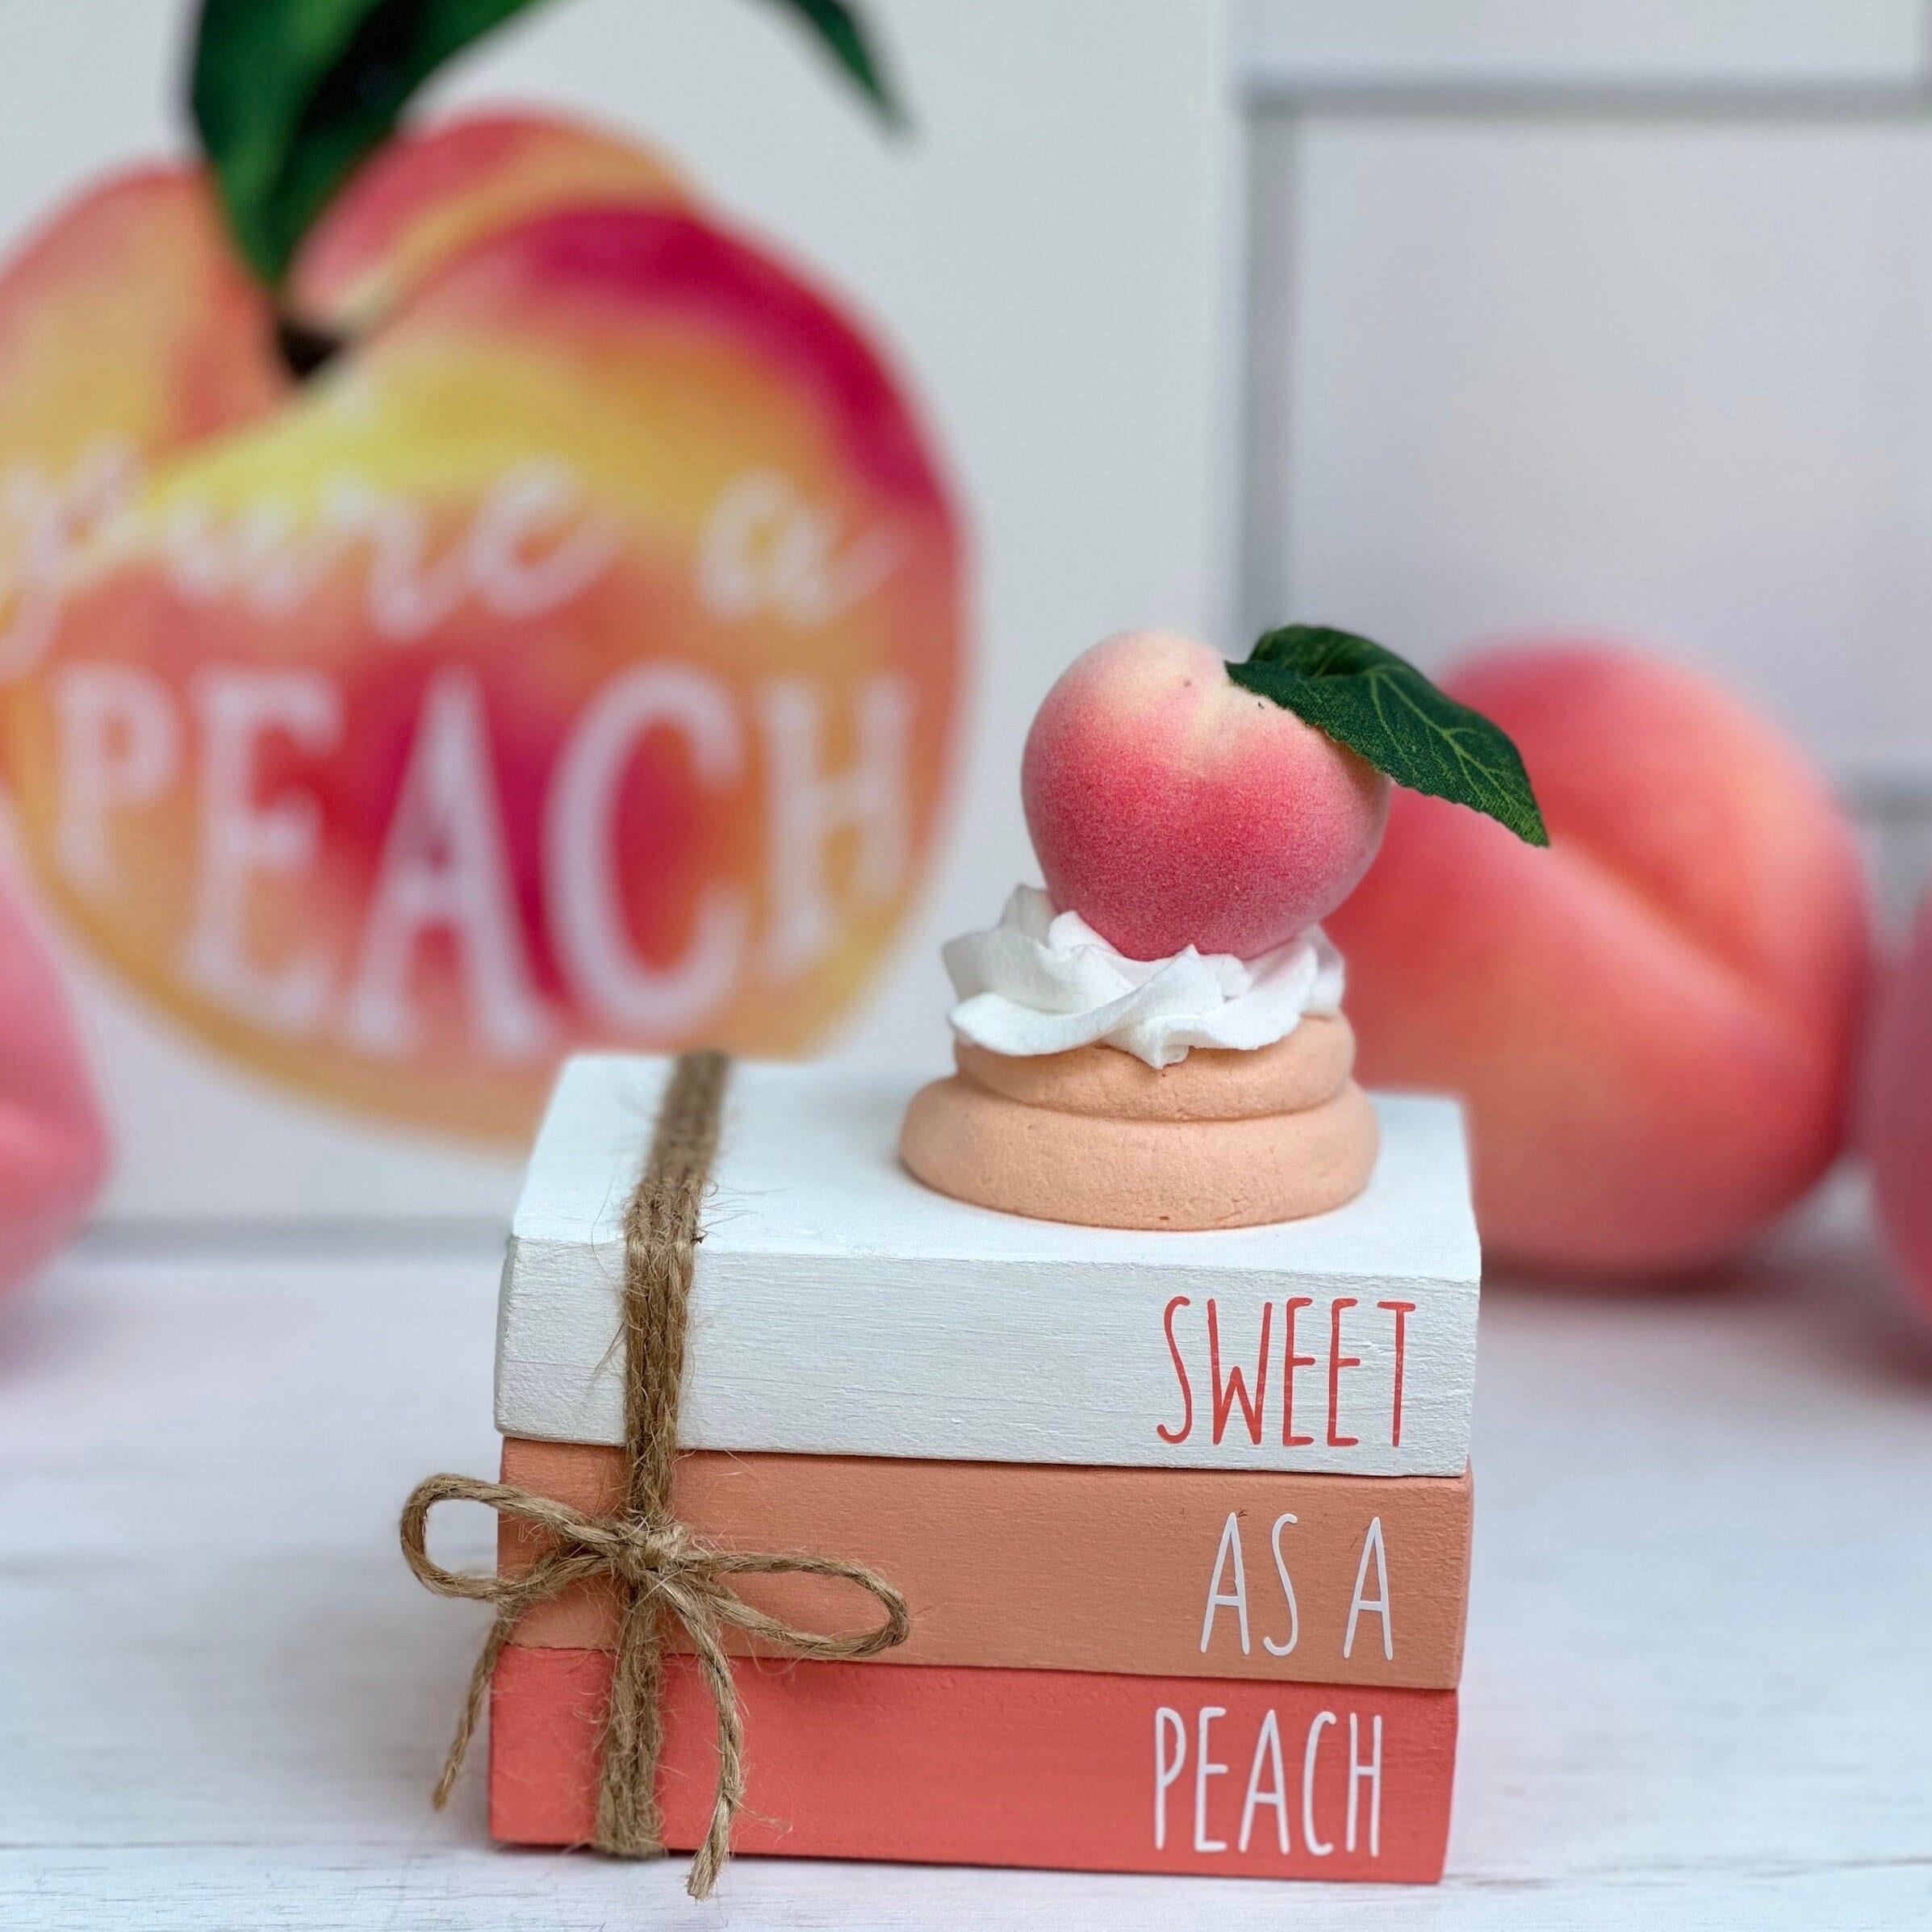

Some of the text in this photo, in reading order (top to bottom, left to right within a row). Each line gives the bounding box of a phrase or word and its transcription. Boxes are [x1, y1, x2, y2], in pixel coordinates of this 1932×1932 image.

[690, 466, 912, 628] a
[50, 658, 928, 1059] PEACH
[1156, 1296, 1416, 1447] SWEET
[1200, 1512, 1394, 1661] AS A
[1155, 1707, 1382, 1858] PEACH
